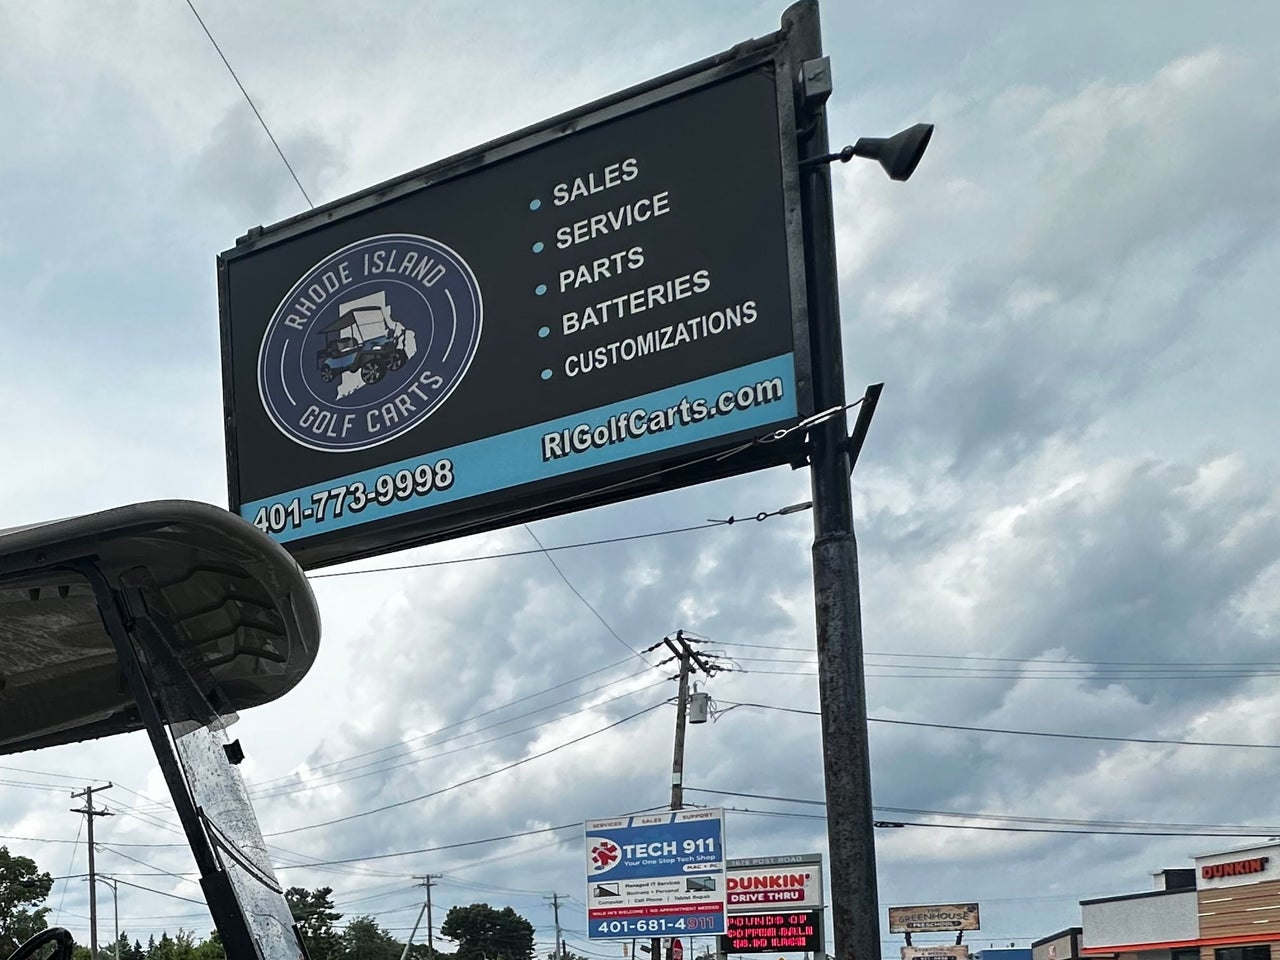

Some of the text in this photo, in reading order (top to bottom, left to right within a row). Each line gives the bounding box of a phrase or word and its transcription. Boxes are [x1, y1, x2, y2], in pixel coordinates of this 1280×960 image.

[553, 158, 639, 206] SALES
[556, 191, 670, 249] SERVICE
[284, 250, 446, 330] RHODE ISLAND
[559, 246, 645, 293] PARTS
[562, 270, 711, 335] BATTERIES
[565, 301, 758, 377] CUSTOMIZATIONS
[299, 370, 444, 438] GOLF CARTS
[542, 375, 784, 462] RIGolfCarts.com
[252, 458, 455, 534] 401-773-9998
[622, 838, 714, 859] TECH 911
[1202, 857, 1269, 880] DUNKIN'
[726, 874, 811, 891] DUNKIN'
[731, 892, 799, 902] DRIVE THRU
[598, 917, 715, 933] 401-681-4911
[898, 912, 970, 923] GREENHOUSE
